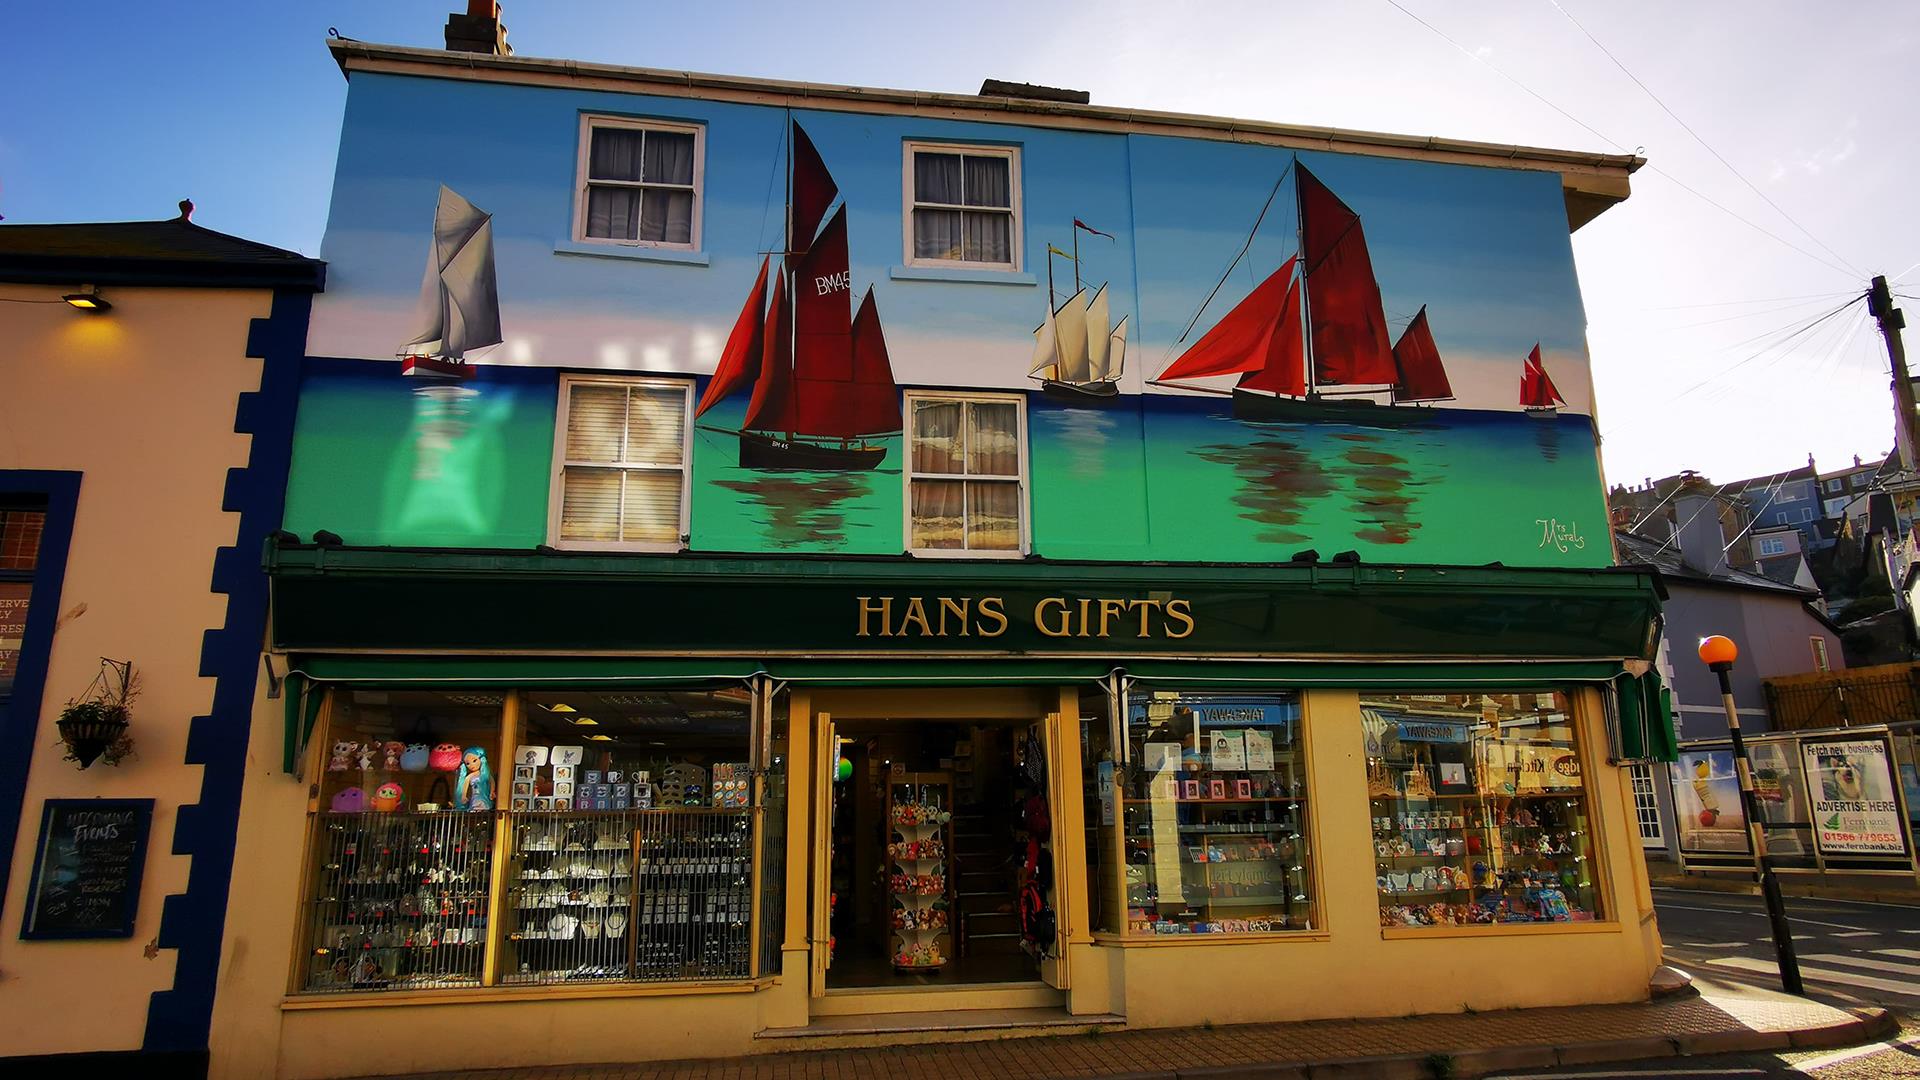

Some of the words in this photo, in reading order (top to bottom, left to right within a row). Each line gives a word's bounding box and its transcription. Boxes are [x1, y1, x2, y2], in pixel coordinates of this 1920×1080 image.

[815, 270, 850, 296] BM45
[855, 596, 1009, 637] HANS
[1034, 597, 1196, 639] GIFTS
[1807, 745, 1829, 756] Fetch
[1848, 743, 1884, 754] business
[1816, 801, 1867, 812] ADVERTISE
[1869, 801, 1896, 812] HERE
[1822, 843, 1903, 852] www.fernbank.biz
